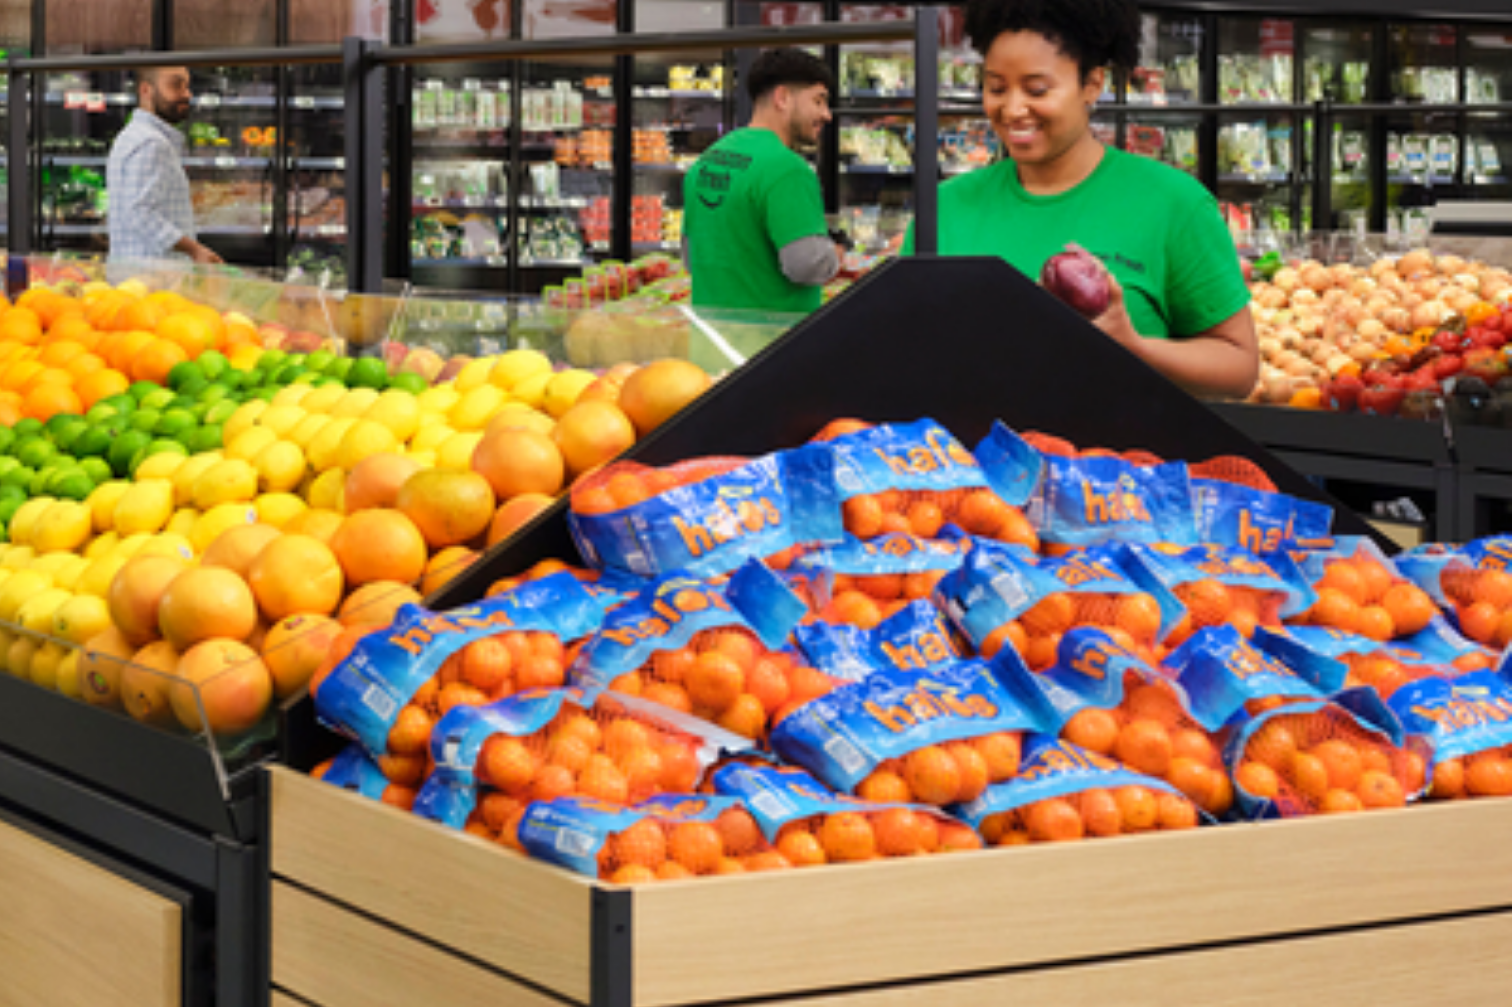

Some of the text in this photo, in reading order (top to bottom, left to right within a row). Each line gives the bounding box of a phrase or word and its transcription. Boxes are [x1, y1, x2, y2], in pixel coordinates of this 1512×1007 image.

[872, 428, 981, 476] halo
[669, 495, 781, 557] halos
[879, 617, 962, 672] hal
[861, 683, 1000, 734] halos
